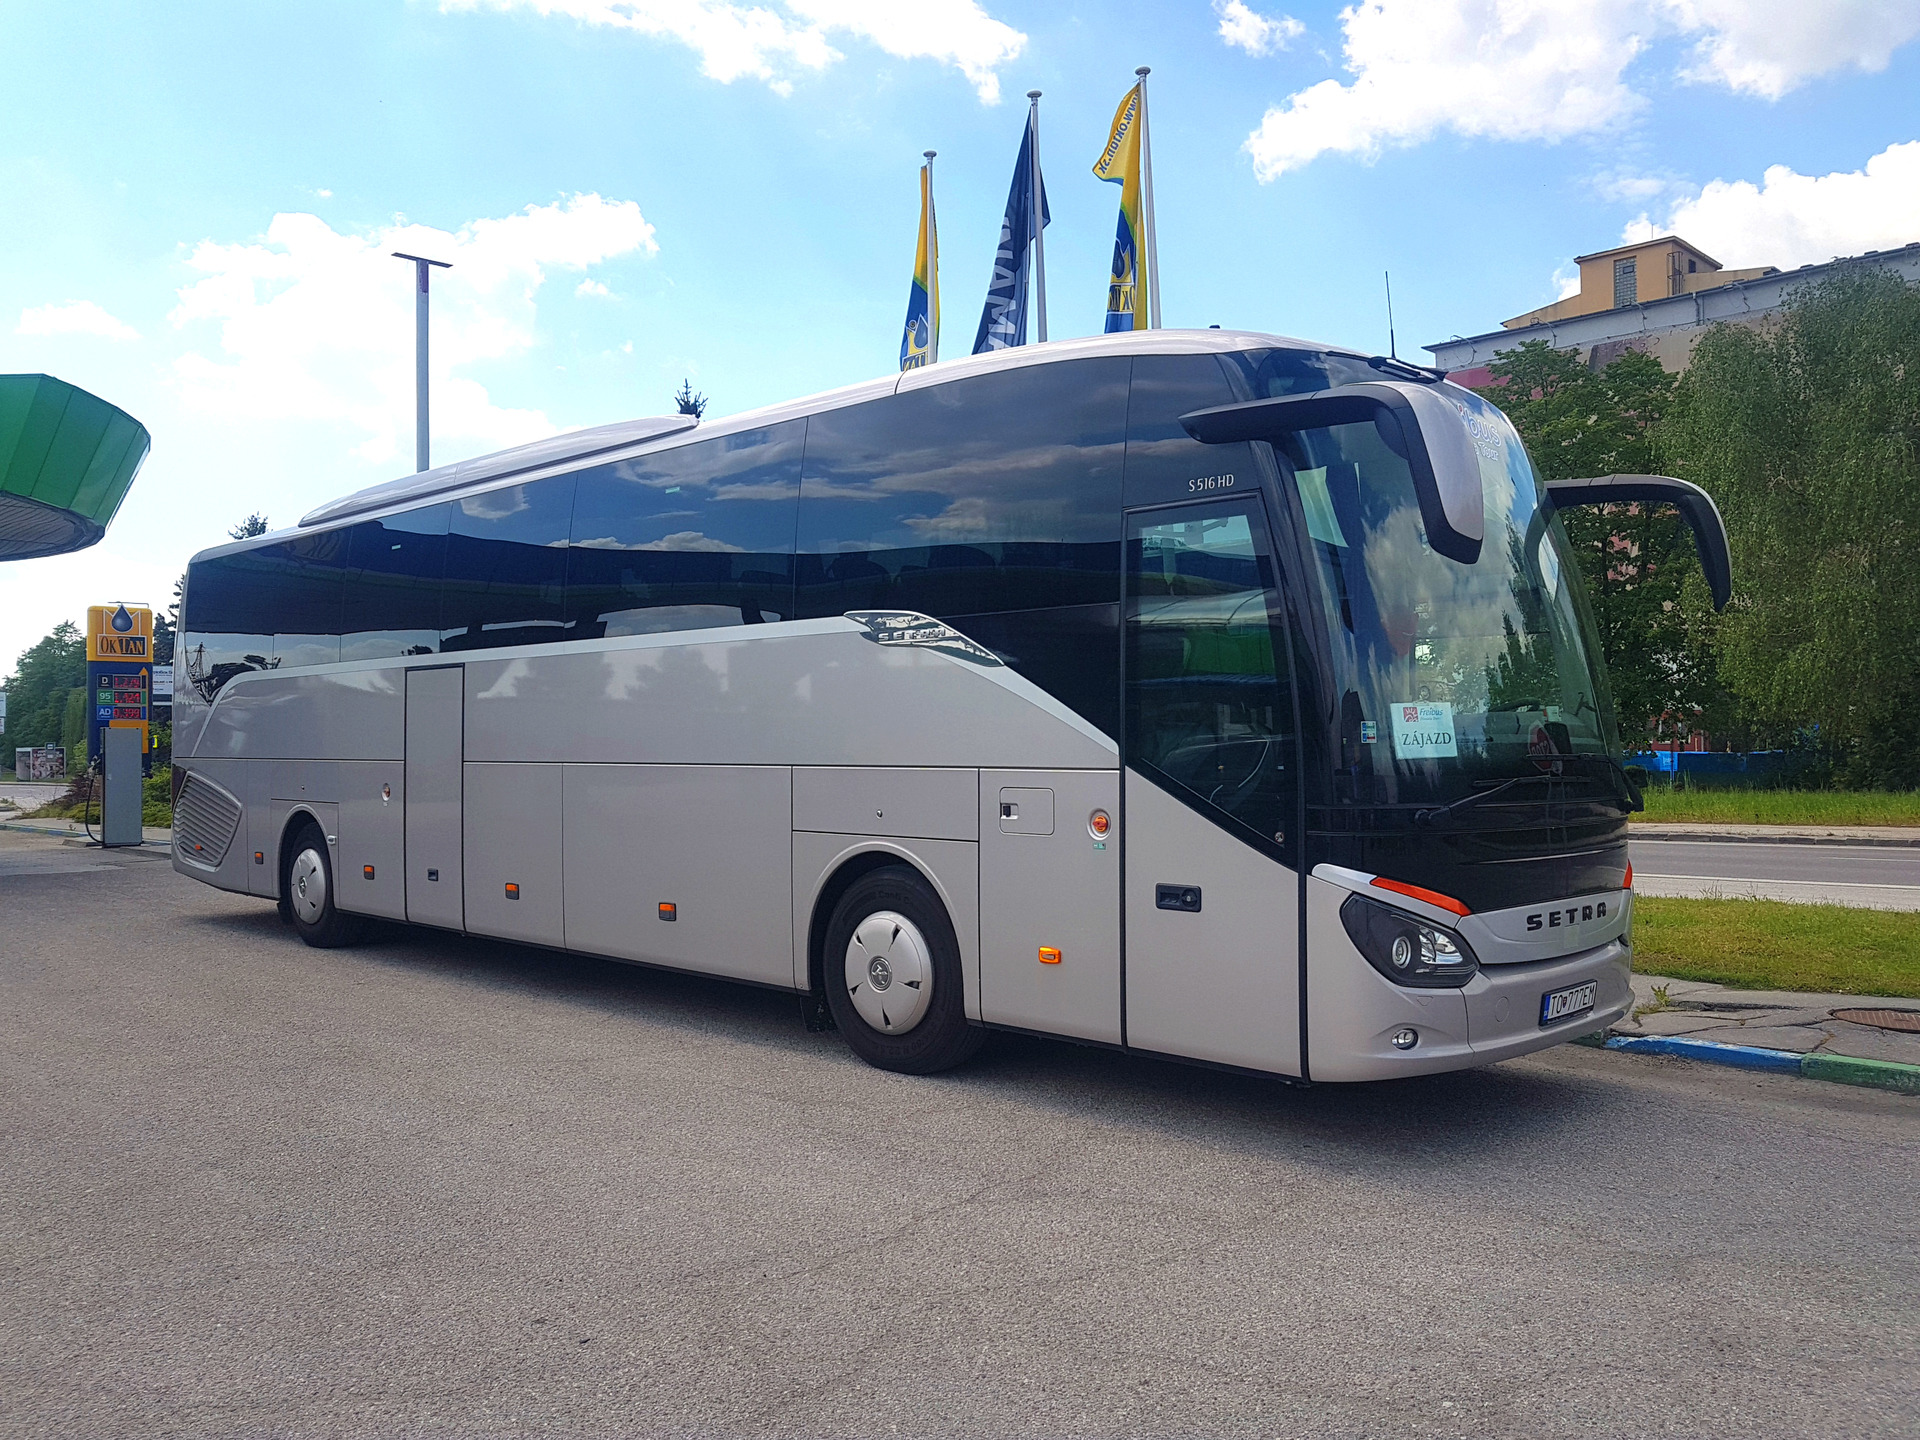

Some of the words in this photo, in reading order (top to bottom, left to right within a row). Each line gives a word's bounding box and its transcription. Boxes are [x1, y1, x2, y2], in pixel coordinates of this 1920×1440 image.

[1188, 479, 1196, 492] S
[1197, 476, 1215, 491] 516
[1217, 474, 1235, 488] HD
[878, 624, 947, 641] SETRA
[99, 692, 111, 700] 95
[1401, 730, 1452, 749] ZÁJAZD
[1526, 901, 1607, 932] SETRA
